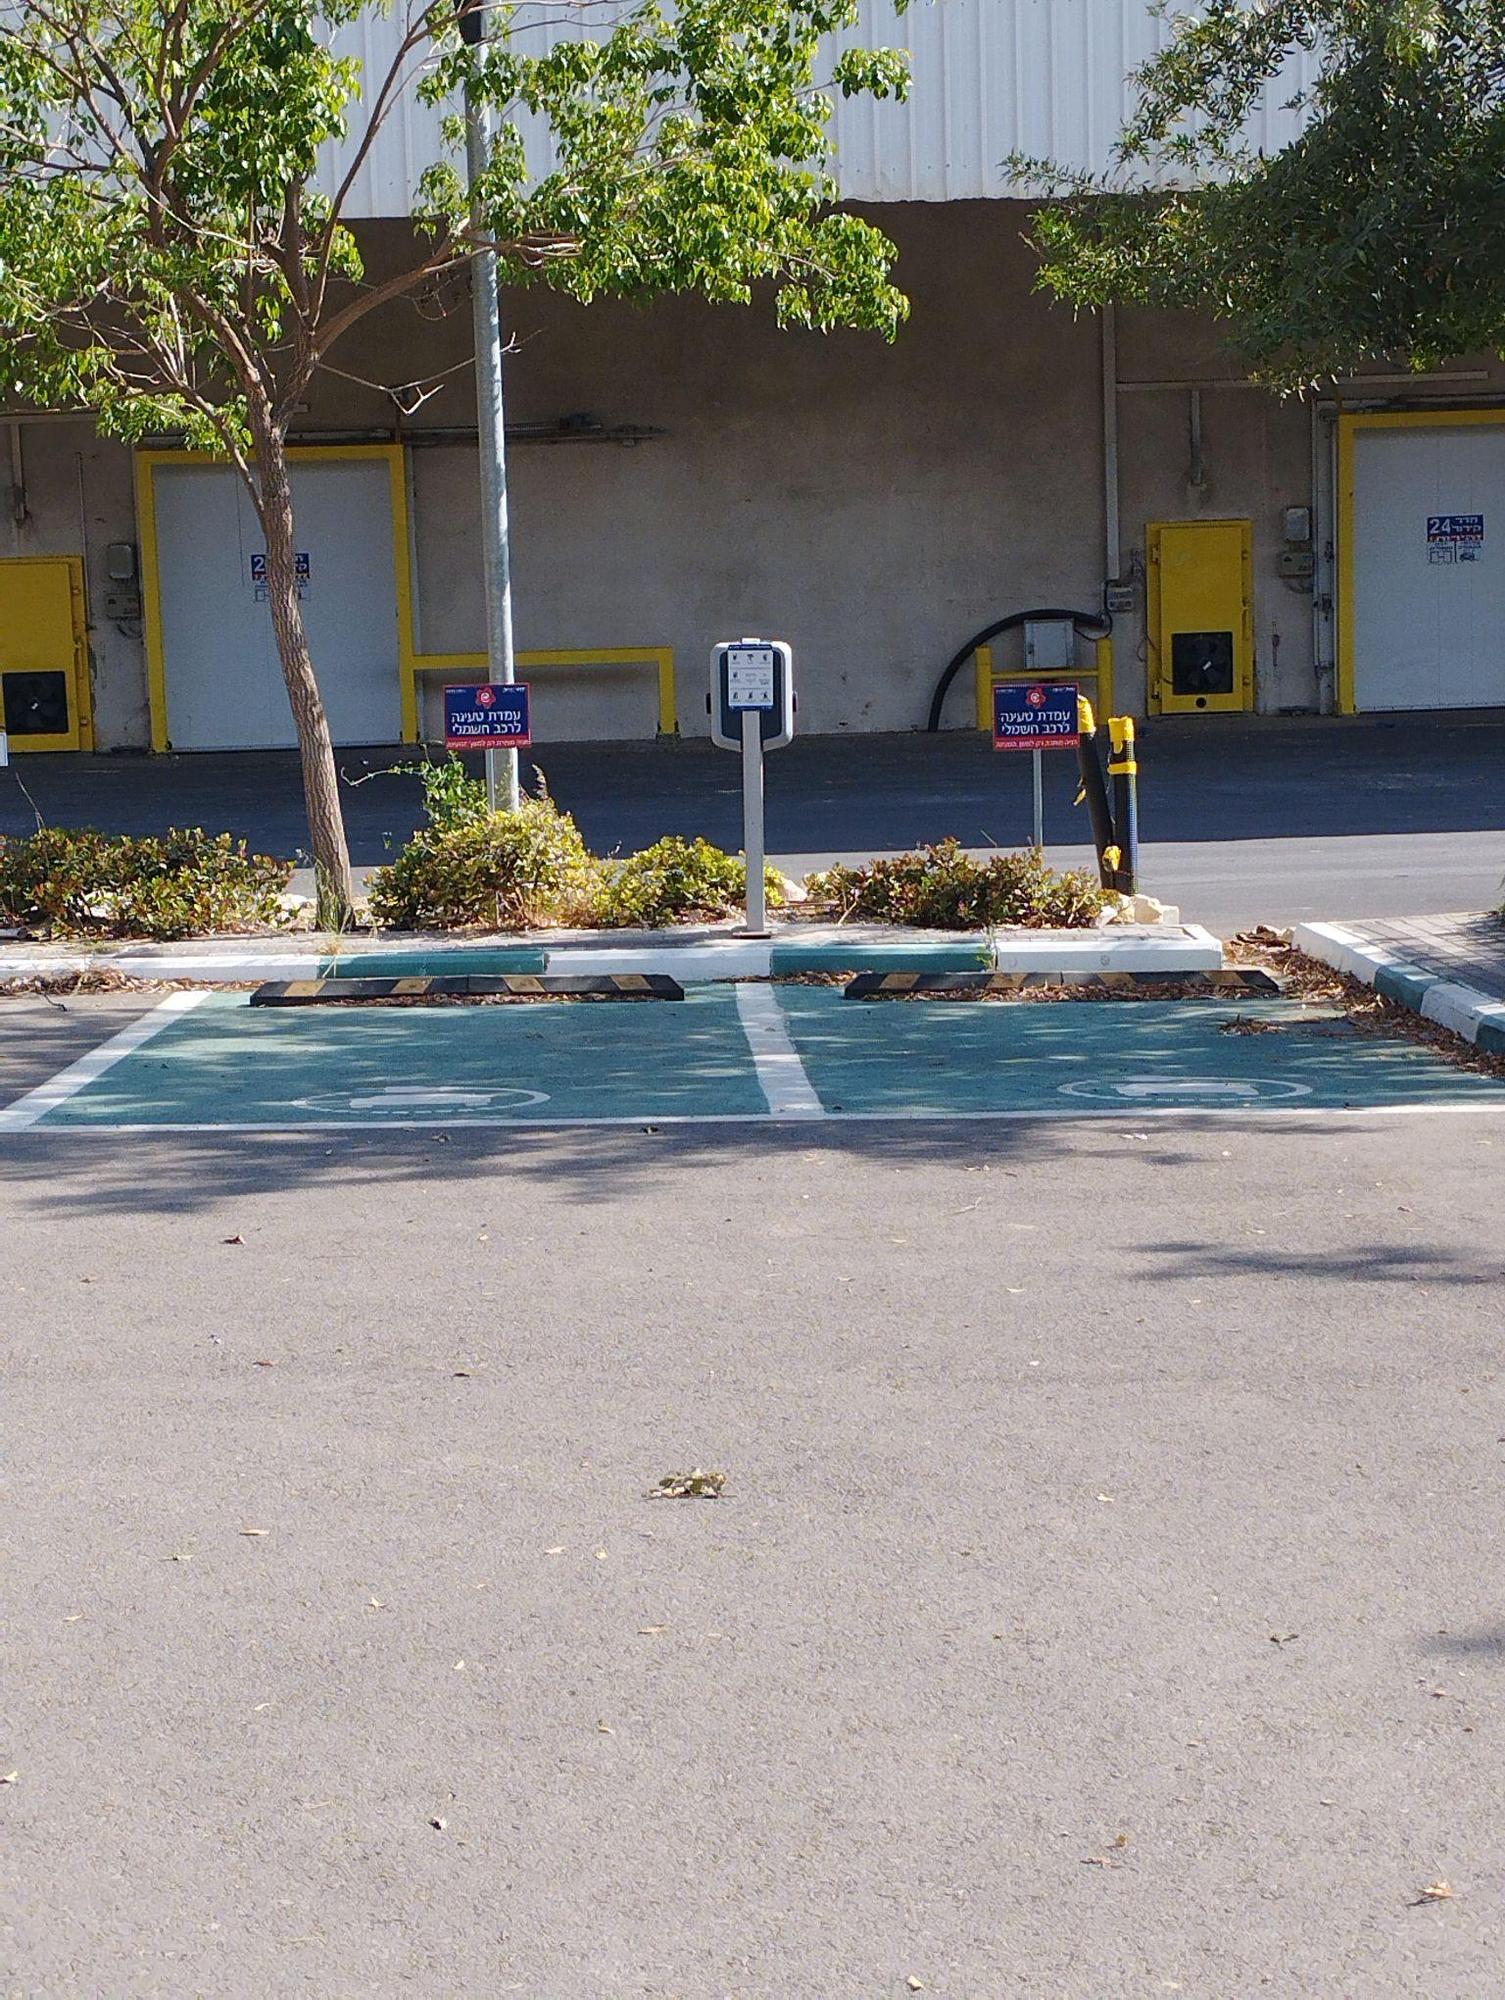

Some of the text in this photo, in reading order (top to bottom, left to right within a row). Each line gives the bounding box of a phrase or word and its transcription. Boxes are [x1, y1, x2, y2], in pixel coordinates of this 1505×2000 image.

[1429, 518, 1451, 534] 24
[253, 556, 265, 572] 2
[451, 710, 521, 723] עמדת טעינה
[1000, 711, 1071, 723] עמדת טעינה
[452, 721, 521, 735] לרכב חשמלי
[1001, 721, 1071, 735] לרכב חשמלי
